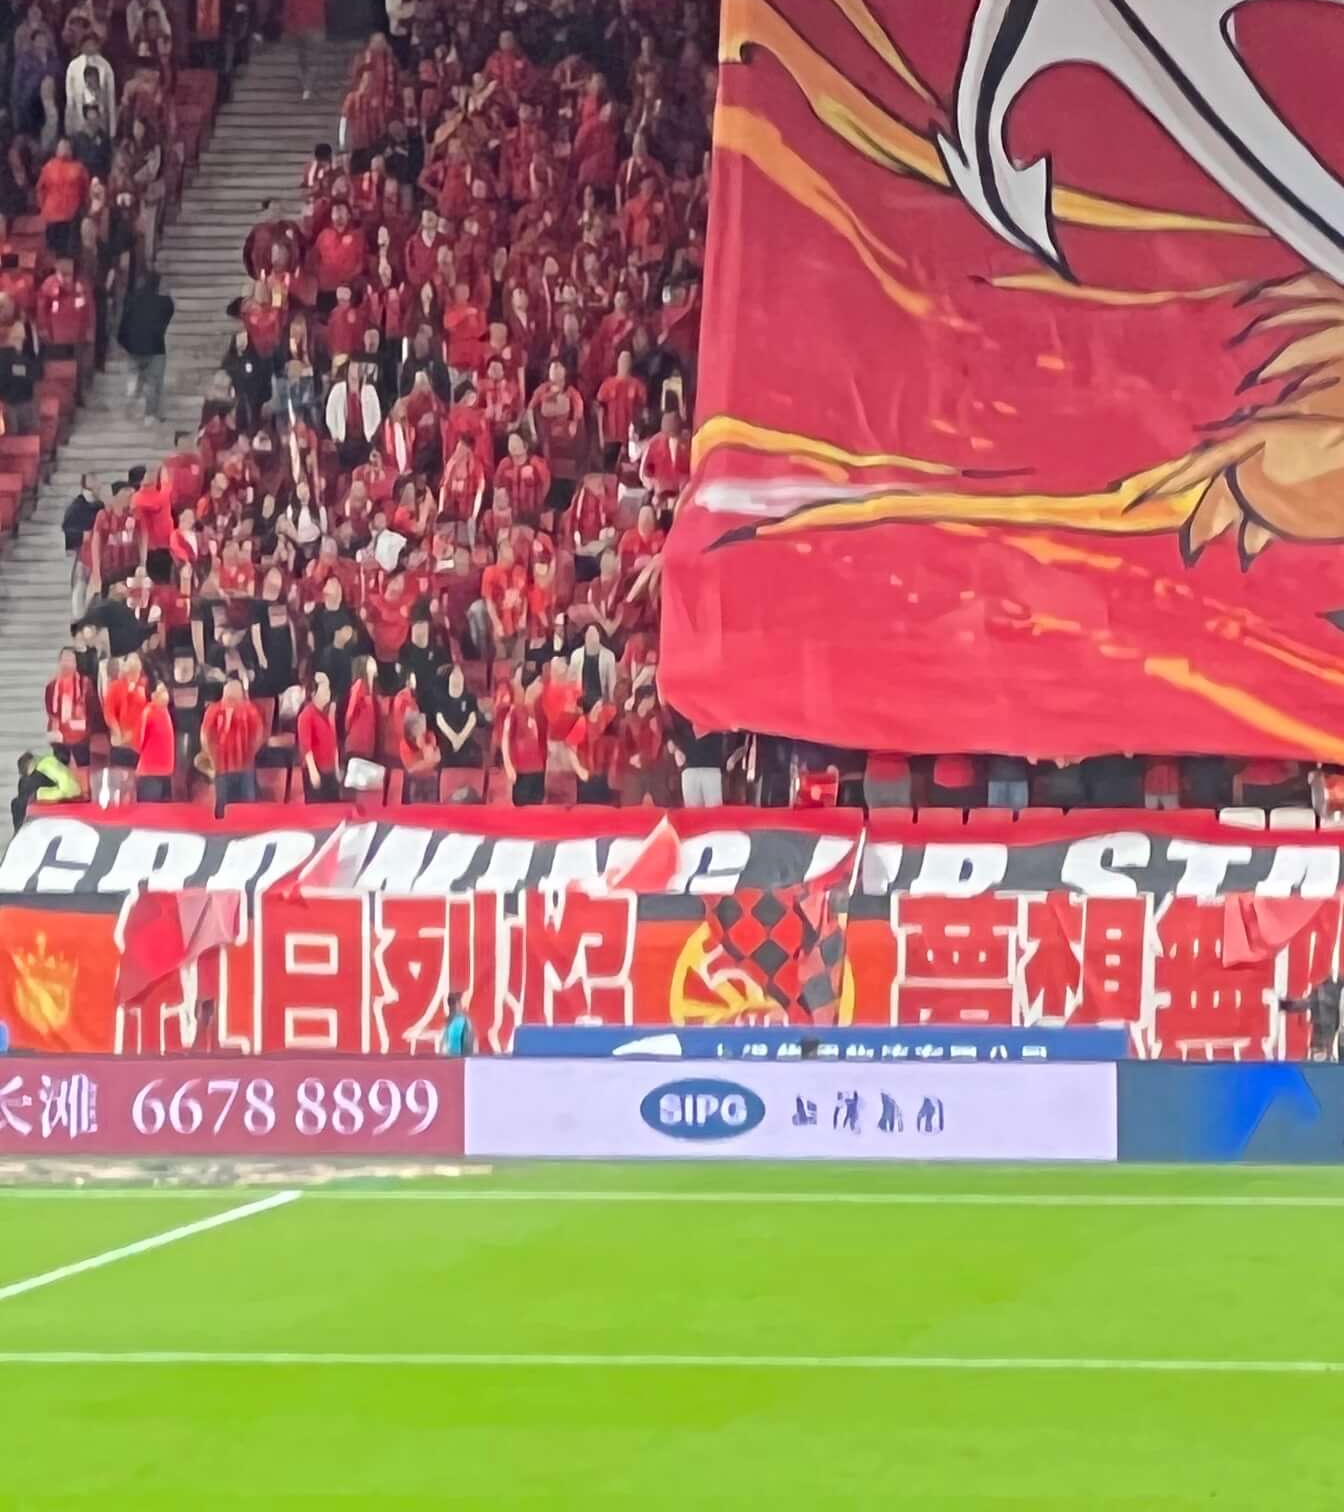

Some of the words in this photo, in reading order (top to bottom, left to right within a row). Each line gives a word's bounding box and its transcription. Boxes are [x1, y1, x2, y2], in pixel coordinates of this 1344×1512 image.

[132, 1078, 276, 1135] 6678
[295, 1078, 439, 1135] 8899
[658, 1094, 748, 1127] SIPG
